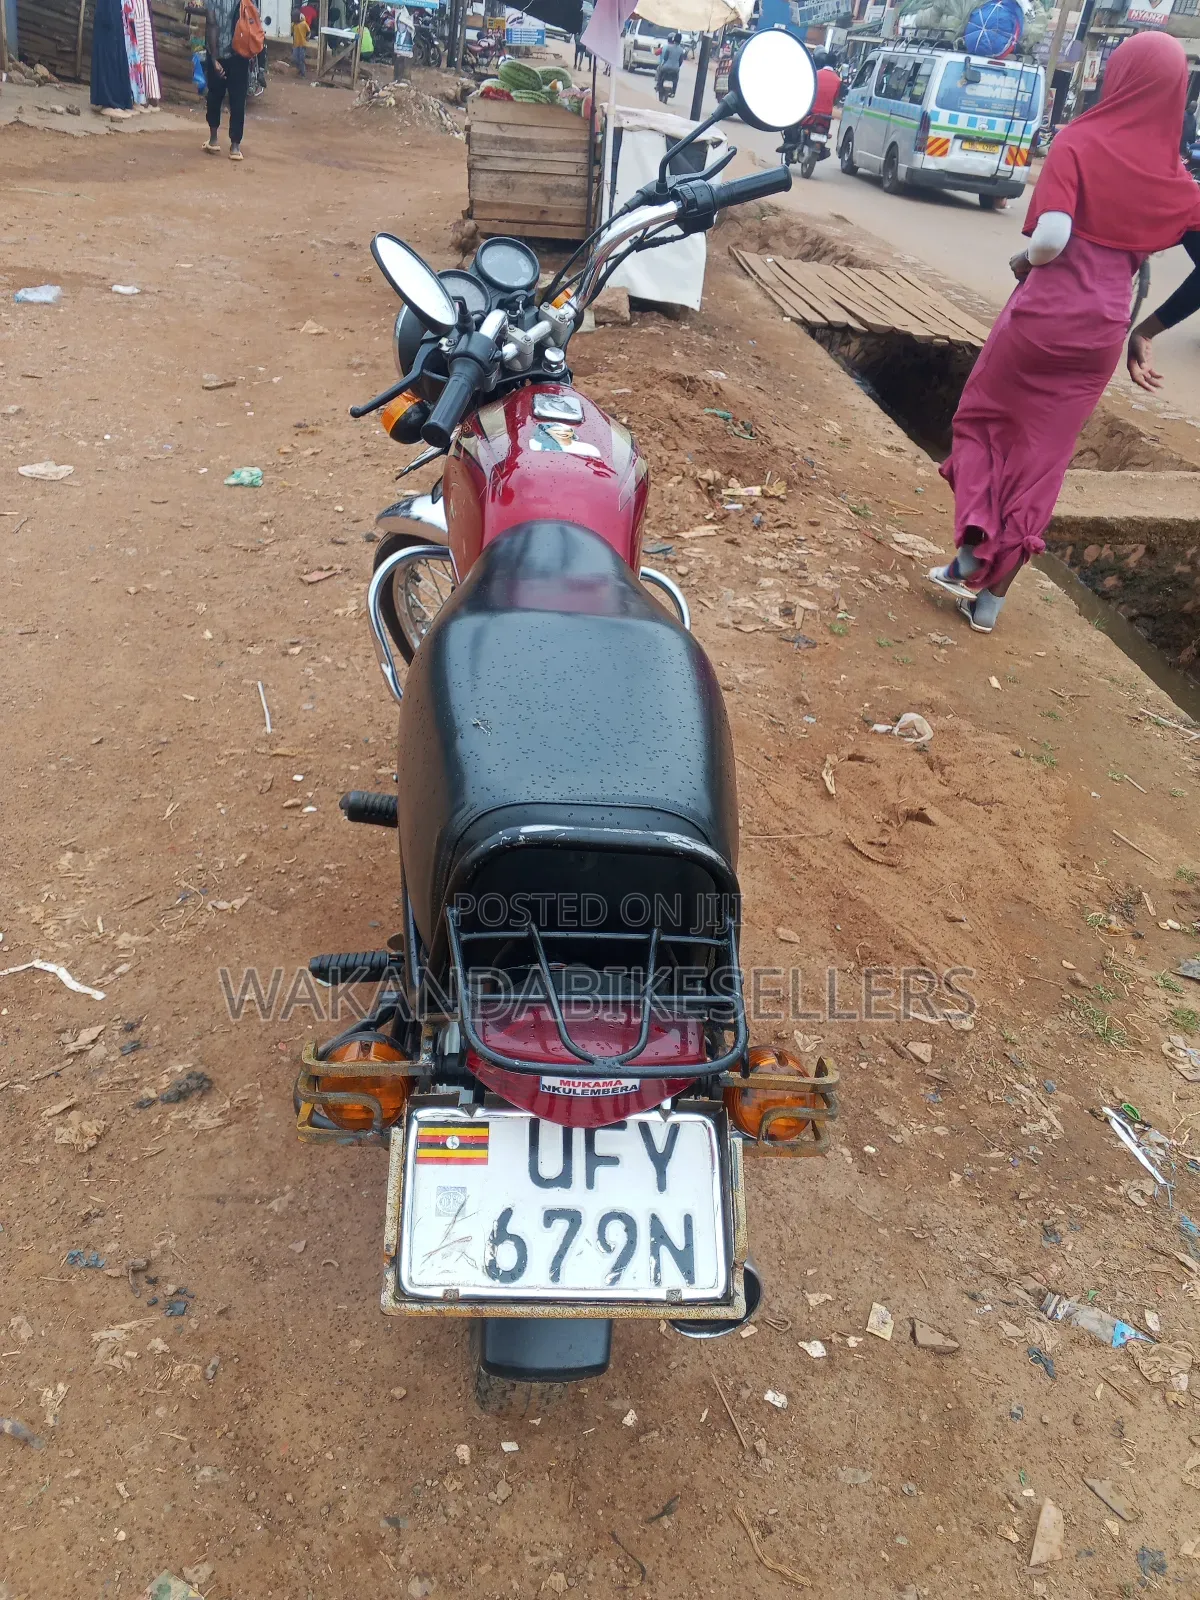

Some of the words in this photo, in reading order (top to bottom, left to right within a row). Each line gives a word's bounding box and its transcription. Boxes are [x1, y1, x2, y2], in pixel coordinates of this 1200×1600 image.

[1130, 10, 1165, 21] NYANZI
[541, 1084, 638, 1096] NKULEMBERA
[560, 1079, 623, 1089] MUKAMA
[528, 1117, 680, 1193] UFY
[484, 1206, 696, 1287] 679N
